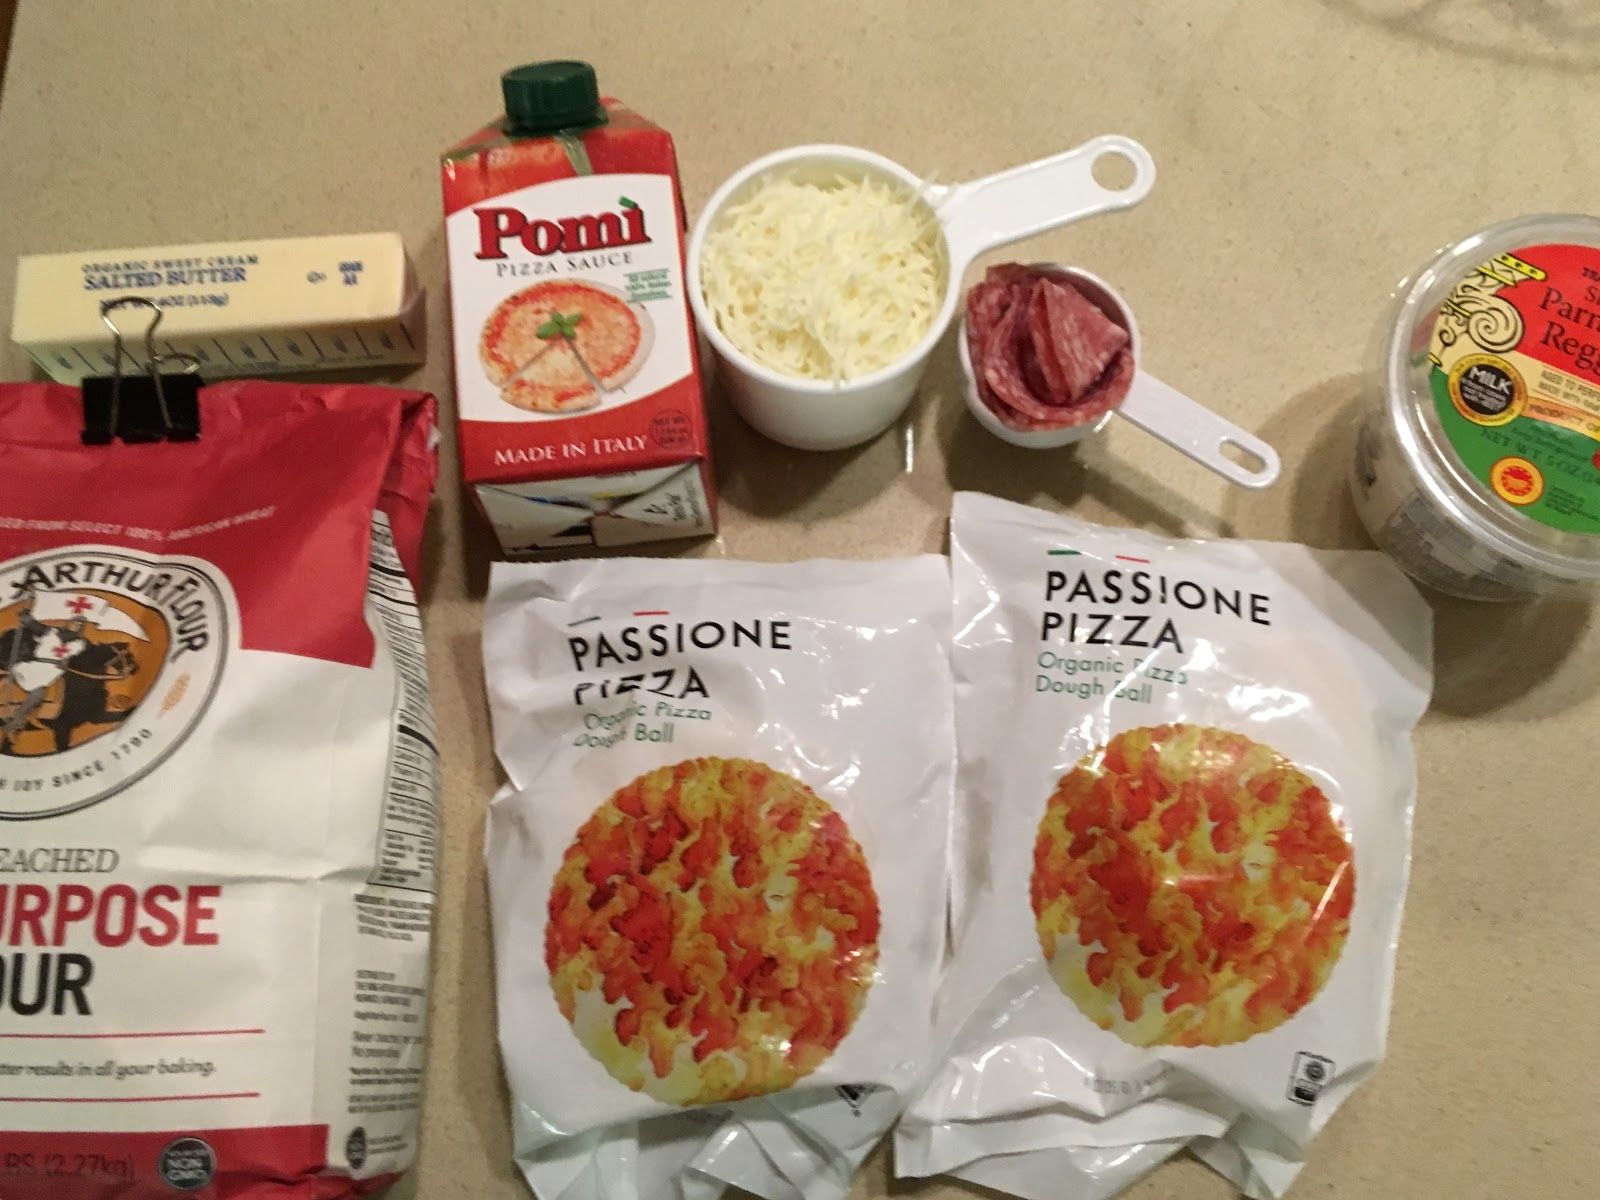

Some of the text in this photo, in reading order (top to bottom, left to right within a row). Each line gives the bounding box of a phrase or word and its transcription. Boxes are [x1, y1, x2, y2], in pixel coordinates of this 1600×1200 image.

[82, 254, 259, 273] ORGANIC SWEET CREAM
[495, 251, 634, 278] PIZZA SAUCE
[84, 267, 247, 290] SALTED BUTTER
[1469, 366, 1512, 395] MILK
[494, 446, 556, 466] MADE
[562, 443, 586, 459] IN
[593, 435, 649, 455] ITALY
[1046, 569, 1271, 626] PASSIONE
[24, 560, 209, 664] ARTHUR FLOUR
[568, 619, 792, 672] PASSIONE
[1041, 611, 1184, 654] PIZZA
[1037, 651, 1124, 675] Organic
[1035, 674, 1104, 699] Dough
[655, 701, 712, 721] Pizza
[634, 723, 674, 743] Ball
[52, 760, 104, 787] SINCE
[0, 884, 222, 948] RPOSE
[0, 952, 94, 1016] UR
[116, 1065, 154, 1080] your
